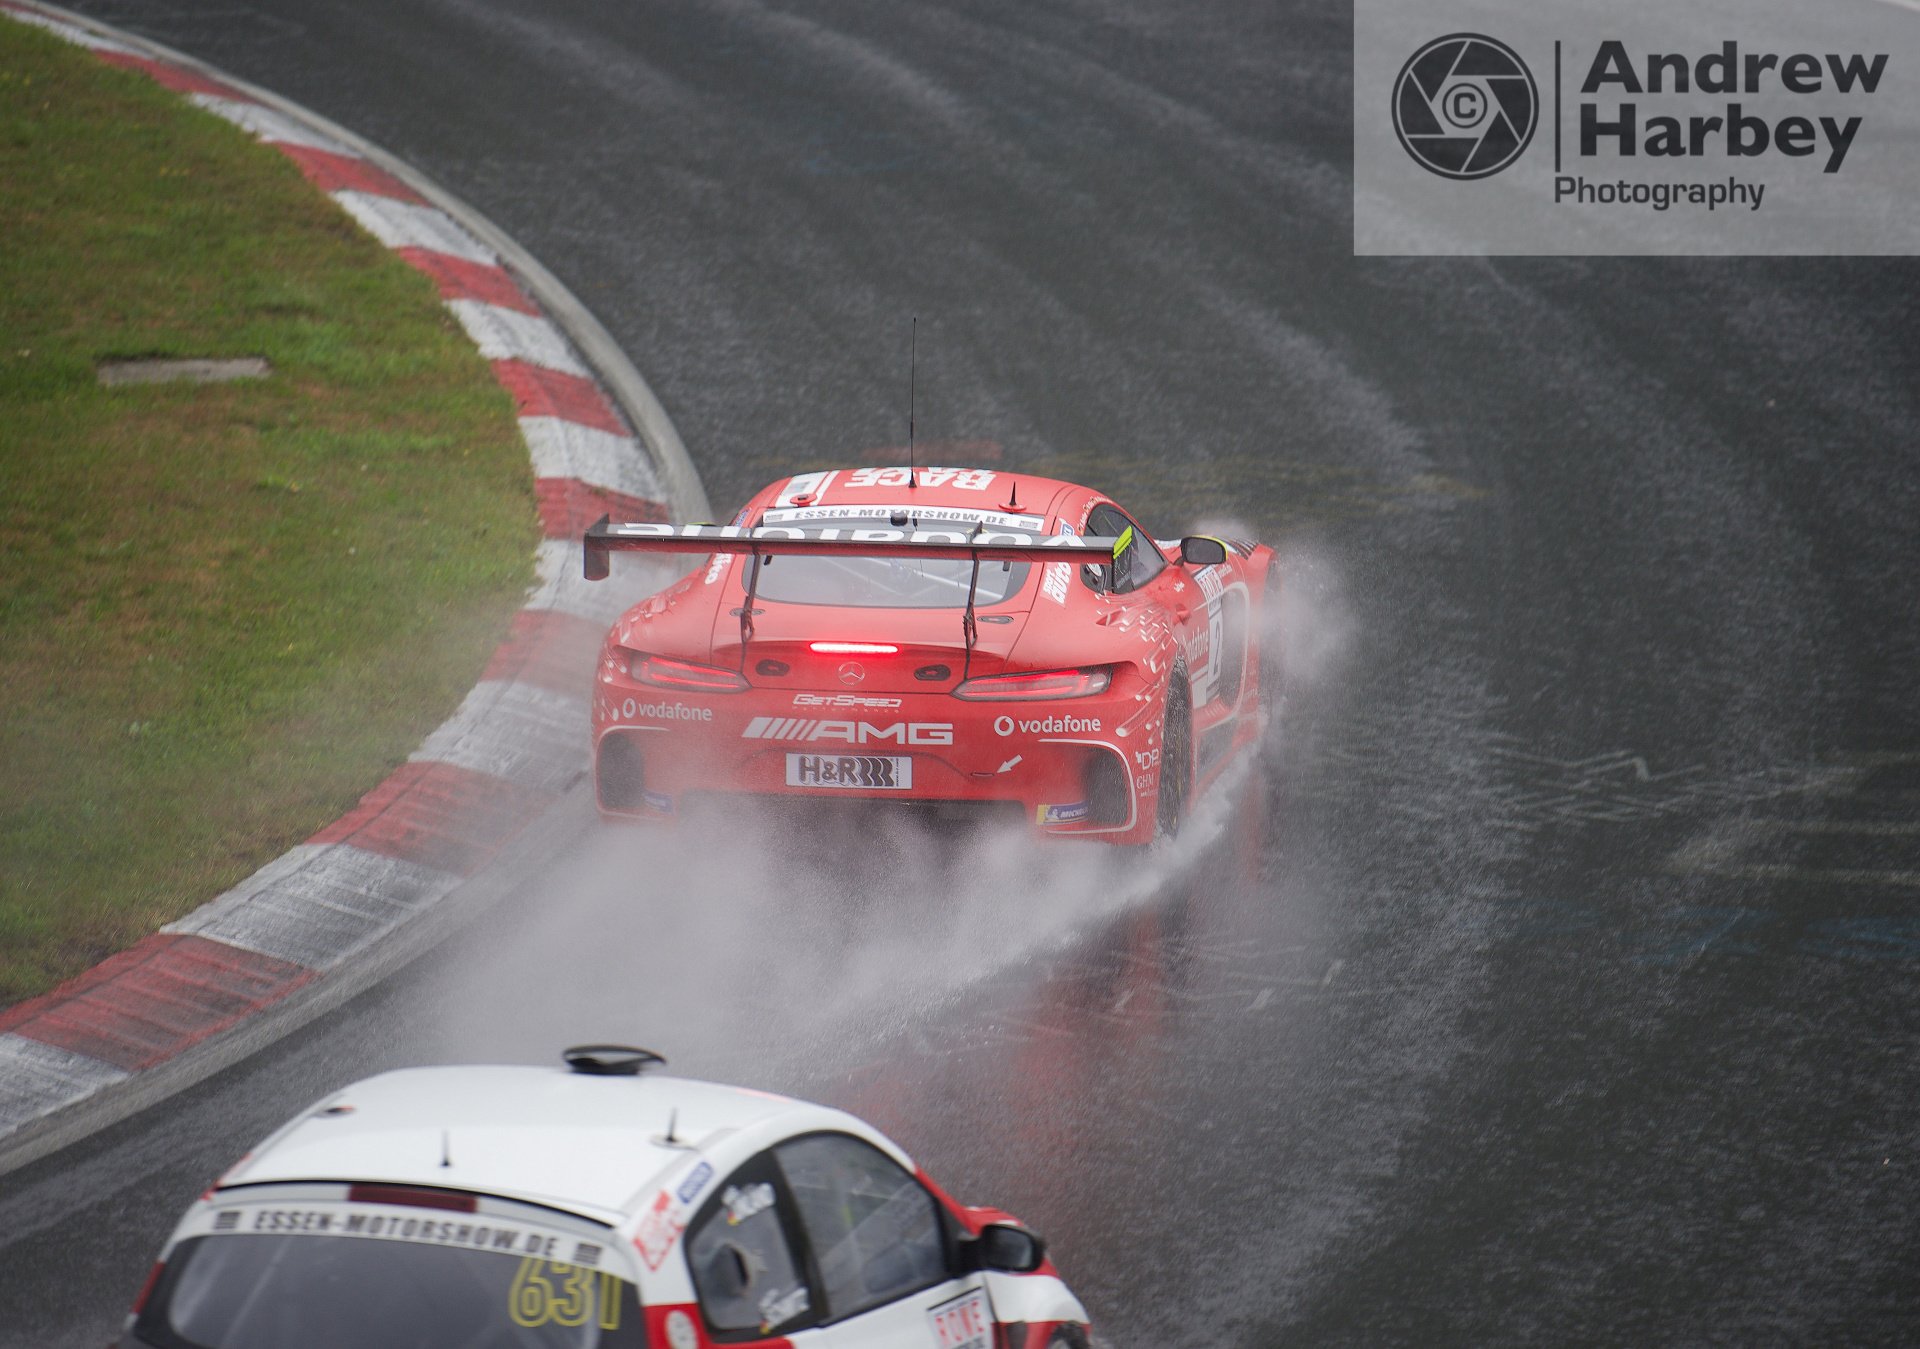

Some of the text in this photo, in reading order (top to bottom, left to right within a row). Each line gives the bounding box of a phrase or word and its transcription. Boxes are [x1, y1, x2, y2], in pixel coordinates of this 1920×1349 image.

[844, 466, 997, 491] RACE
[638, 701, 713, 722] vodafone
[1018, 714, 1101, 734] vodafone
[807, 719, 954, 745] AMG
[509, 1256, 621, 1330] 631
